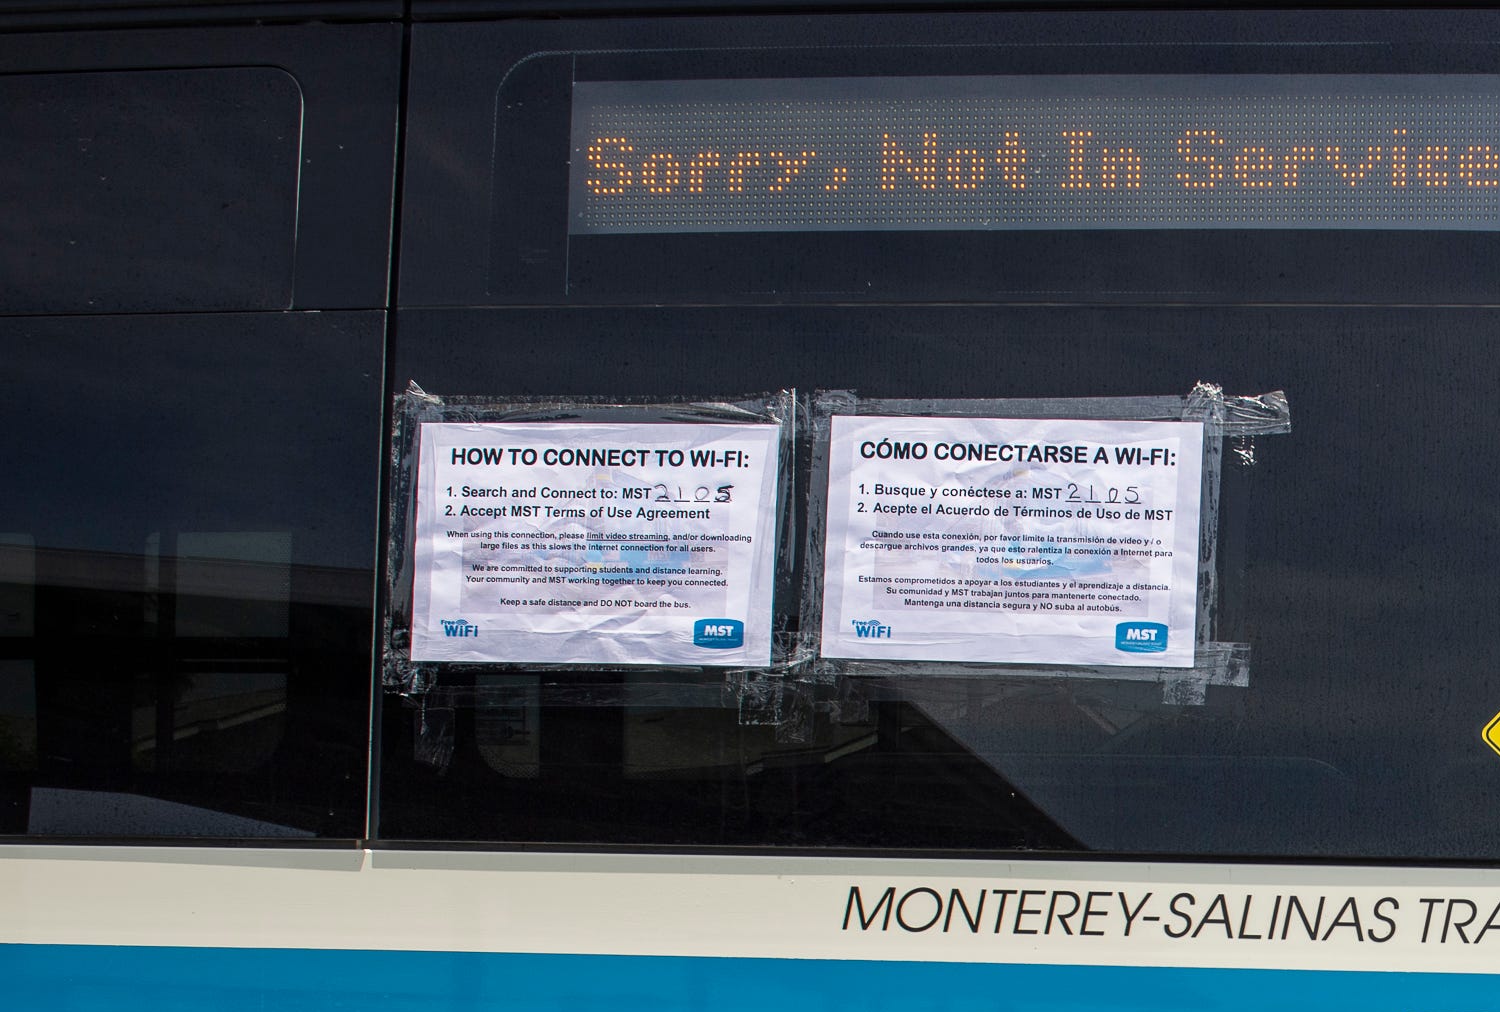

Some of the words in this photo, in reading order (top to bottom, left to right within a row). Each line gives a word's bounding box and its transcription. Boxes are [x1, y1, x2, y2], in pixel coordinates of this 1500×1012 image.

[585, 136, 846, 197] Sorry,
[879, 131, 1028, 192] Not
[1060, 129, 1142, 190] In
[1177, 127, 1500, 190] Service
[451, 447, 503, 466] HOW
[508, 448, 538, 466] TO
[543, 448, 650, 467] CONNECT
[655, 449, 685, 467] TO
[690, 450, 749, 468] WI-FI:
[860, 438, 928, 460] CÓMO
[934, 442, 1088, 464] CONECTARSE
[1093, 446, 1109, 465] A
[1115, 447, 1176, 466] WI-FI:
[446, 486, 457, 497] 1.
[461, 485, 507, 498] Search
[512, 486, 537, 498] and
[541, 486, 597, 499] Connect
[600, 489, 618, 499] to:
[622, 488, 652, 499] MST
[858, 483, 870, 495] 1.
[874, 483, 926, 498] Busque
[929, 488, 938, 499] y
[942, 486, 1011, 499] conéctese
[1015, 489, 1027, 499] a:
[1032, 487, 1062, 499] MST
[445, 505, 456, 517] 2.
[460, 505, 507, 519] Accept
[511, 505, 541, 517] MST
[545, 506, 586, 518] Terms
[590, 506, 604, 518] of
[607, 506, 632, 518] Use
[636, 507, 710, 521] Agreement
[857, 502, 868, 513] 2.
[873, 502, 917, 516] Acepte
[921, 504, 932, 515] el
[935, 504, 990, 516] Acuerdo
[994, 505, 1009, 517] de
[1013, 505, 1073, 519] Términos
[1076, 508, 1092, 519] de
[1096, 508, 1121, 520] Uso
[1125, 509, 1140, 520] de
[1144, 510, 1173, 521] MST
[470, 531, 492, 539] using
[494, 531, 509, 539] this
[511, 531, 557, 540] connection,
[558, 531, 585, 540] please
[586, 532, 604, 541] limit
[628, 533, 671, 542] streaming,
[672, 533, 699, 541] and/or
[700, 534, 752, 543] downloading
[472, 564, 485, 572] We
[500, 565, 543, 573] committed
[554, 566, 597, 574] supporting
[652, 567, 686, 575] distance
[688, 568, 723, 576] learning.
[486, 576, 529, 584] community
[532, 576, 547, 584] and
[548, 576, 567, 584] MST
[568, 576, 599, 585] working
[602, 578, 636, 586] together
[646, 578, 666, 587] keep
[667, 579, 683, 587] you
[684, 579, 729, 587] connected.
[858, 575, 893, 583] Estamos
[894, 577, 956, 585] comprometidos
[964, 579, 991, 587] apoyar
[1000, 579, 1012, 587] los
[1014, 580, 1061, 588] estudiantes
[1069, 581, 1077, 589] el
[1078, 581, 1124, 591] aprendizaje
[1132, 583, 1171, 591] distancia.
[886, 587, 897, 595] Su
[898, 587, 943, 596] comunidad
[970, 590, 1003, 598] trabajan
[1003, 590, 1030, 599] juntos
[1051, 592, 1096, 600] mantenerte
[1098, 594, 1142, 602] conectado.
[500, 598, 521, 607] Keep
[529, 598, 546, 606] safe
[548, 599, 581, 607] distance
[583, 599, 598, 607] and
[634, 600, 657, 608] board
[674, 601, 691, 609] bus.
[904, 598, 944, 608] Mantenga
[963, 600, 1001, 609] distancia
[1002, 602, 1031, 611] segura
[1039, 602, 1053, 610] NO
[1055, 603, 1075, 611] suba
[1077, 603, 1085, 611] al
[1086, 604, 1122, 613] autobús.
[444, 625, 478, 637] WiFi
[704, 625, 734, 637] MST
[856, 626, 891, 638] WiFi
[1126, 628, 1158, 641] MST
[841, 886, 1401, 945] MONTEREY-SALINAS
